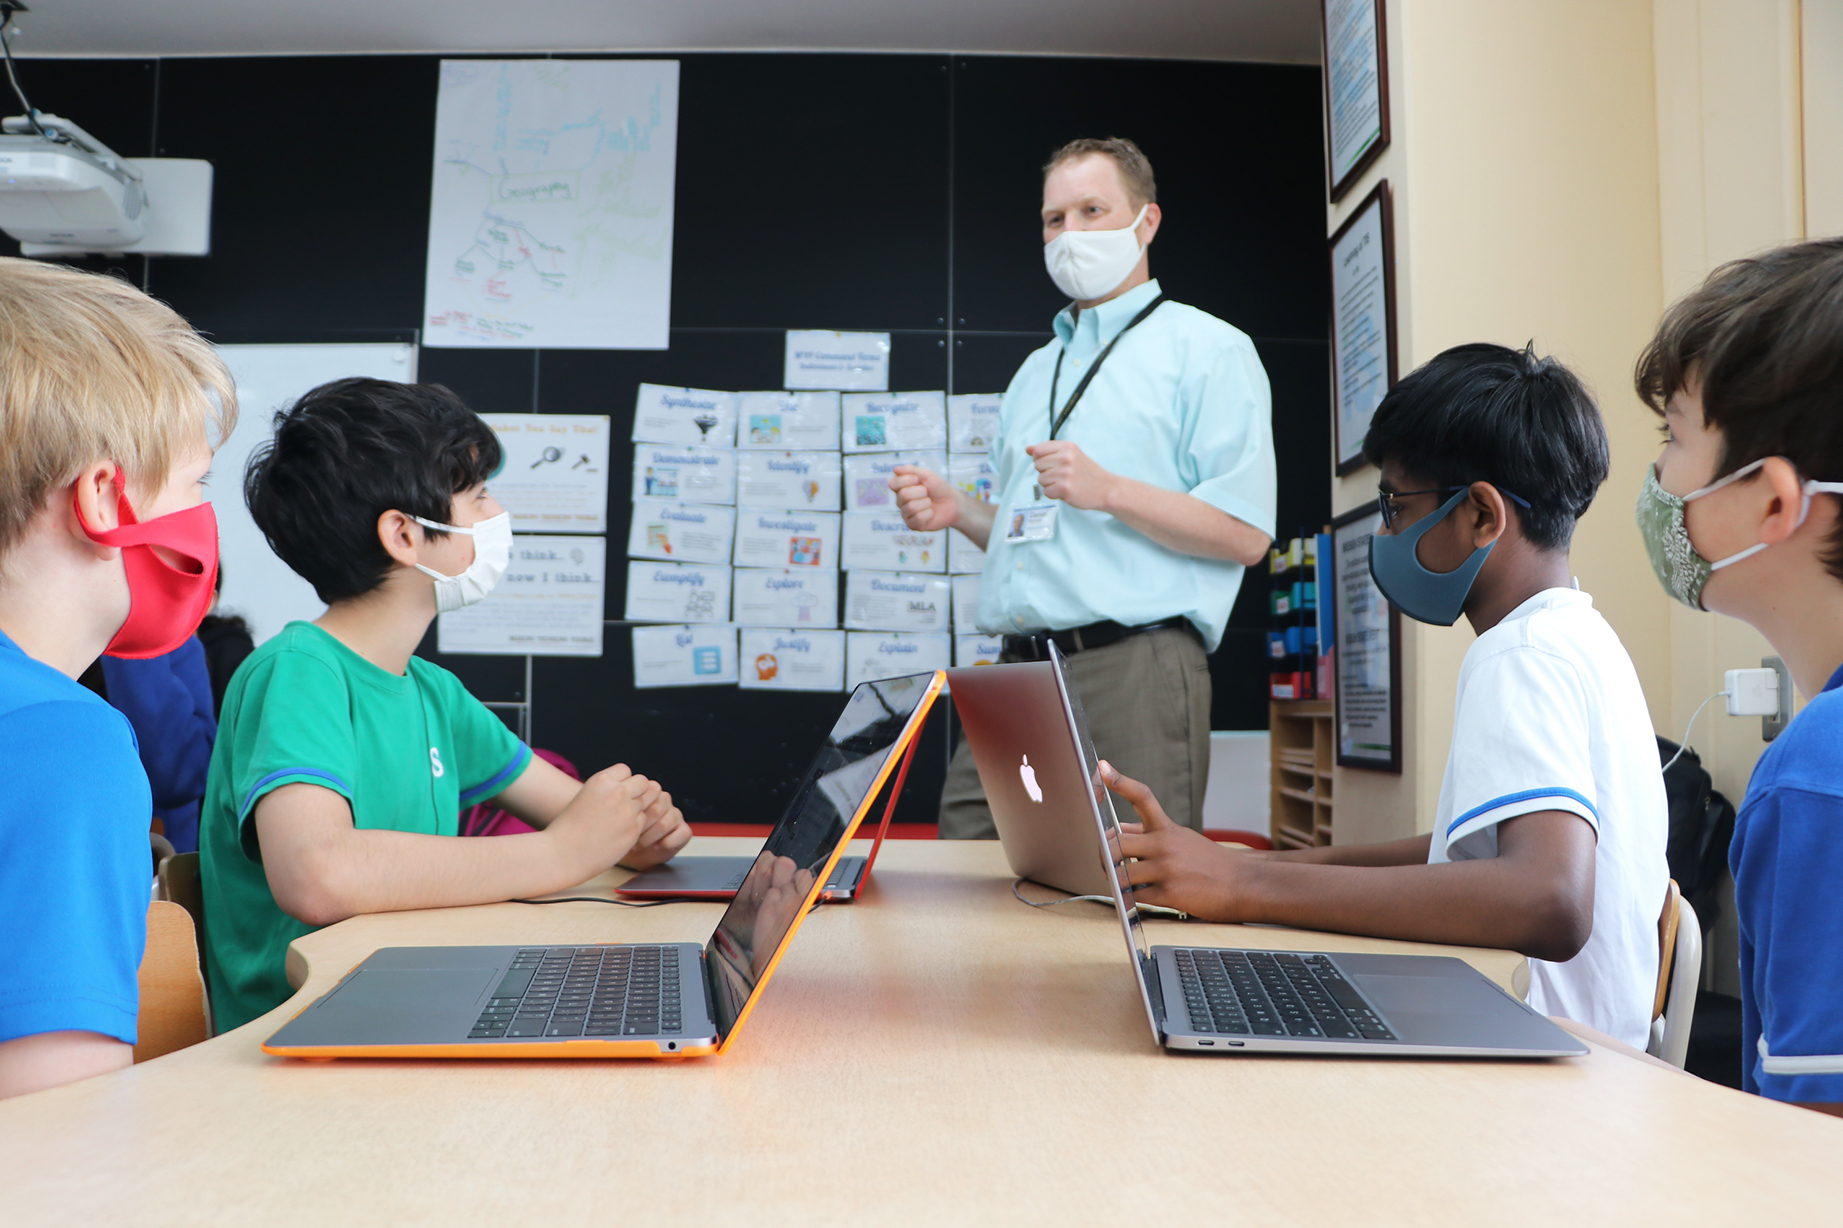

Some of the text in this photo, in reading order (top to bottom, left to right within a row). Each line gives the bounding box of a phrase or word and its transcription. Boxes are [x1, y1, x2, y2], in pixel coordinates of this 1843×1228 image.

[498, 176, 571, 201] Geography
[816, 351, 856, 360] Command
[857, 351, 881, 361] Terms
[866, 402, 920, 415] Recognize
[652, 452, 719, 466] Demonstrate
[766, 459, 810, 475] Identify
[660, 507, 707, 524] Evaluate
[757, 516, 817, 534] Investigate
[506, 574, 535, 583] now
[542, 572, 549, 583] I
[765, 577, 804, 590] Explore
[870, 579, 926, 594] Document
[909, 600, 936, 611] MLA
[675, 633, 693, 648] List
[773, 637, 812, 652] Justify
[878, 641, 918, 655] Explain
[429, 746, 445, 778] S
